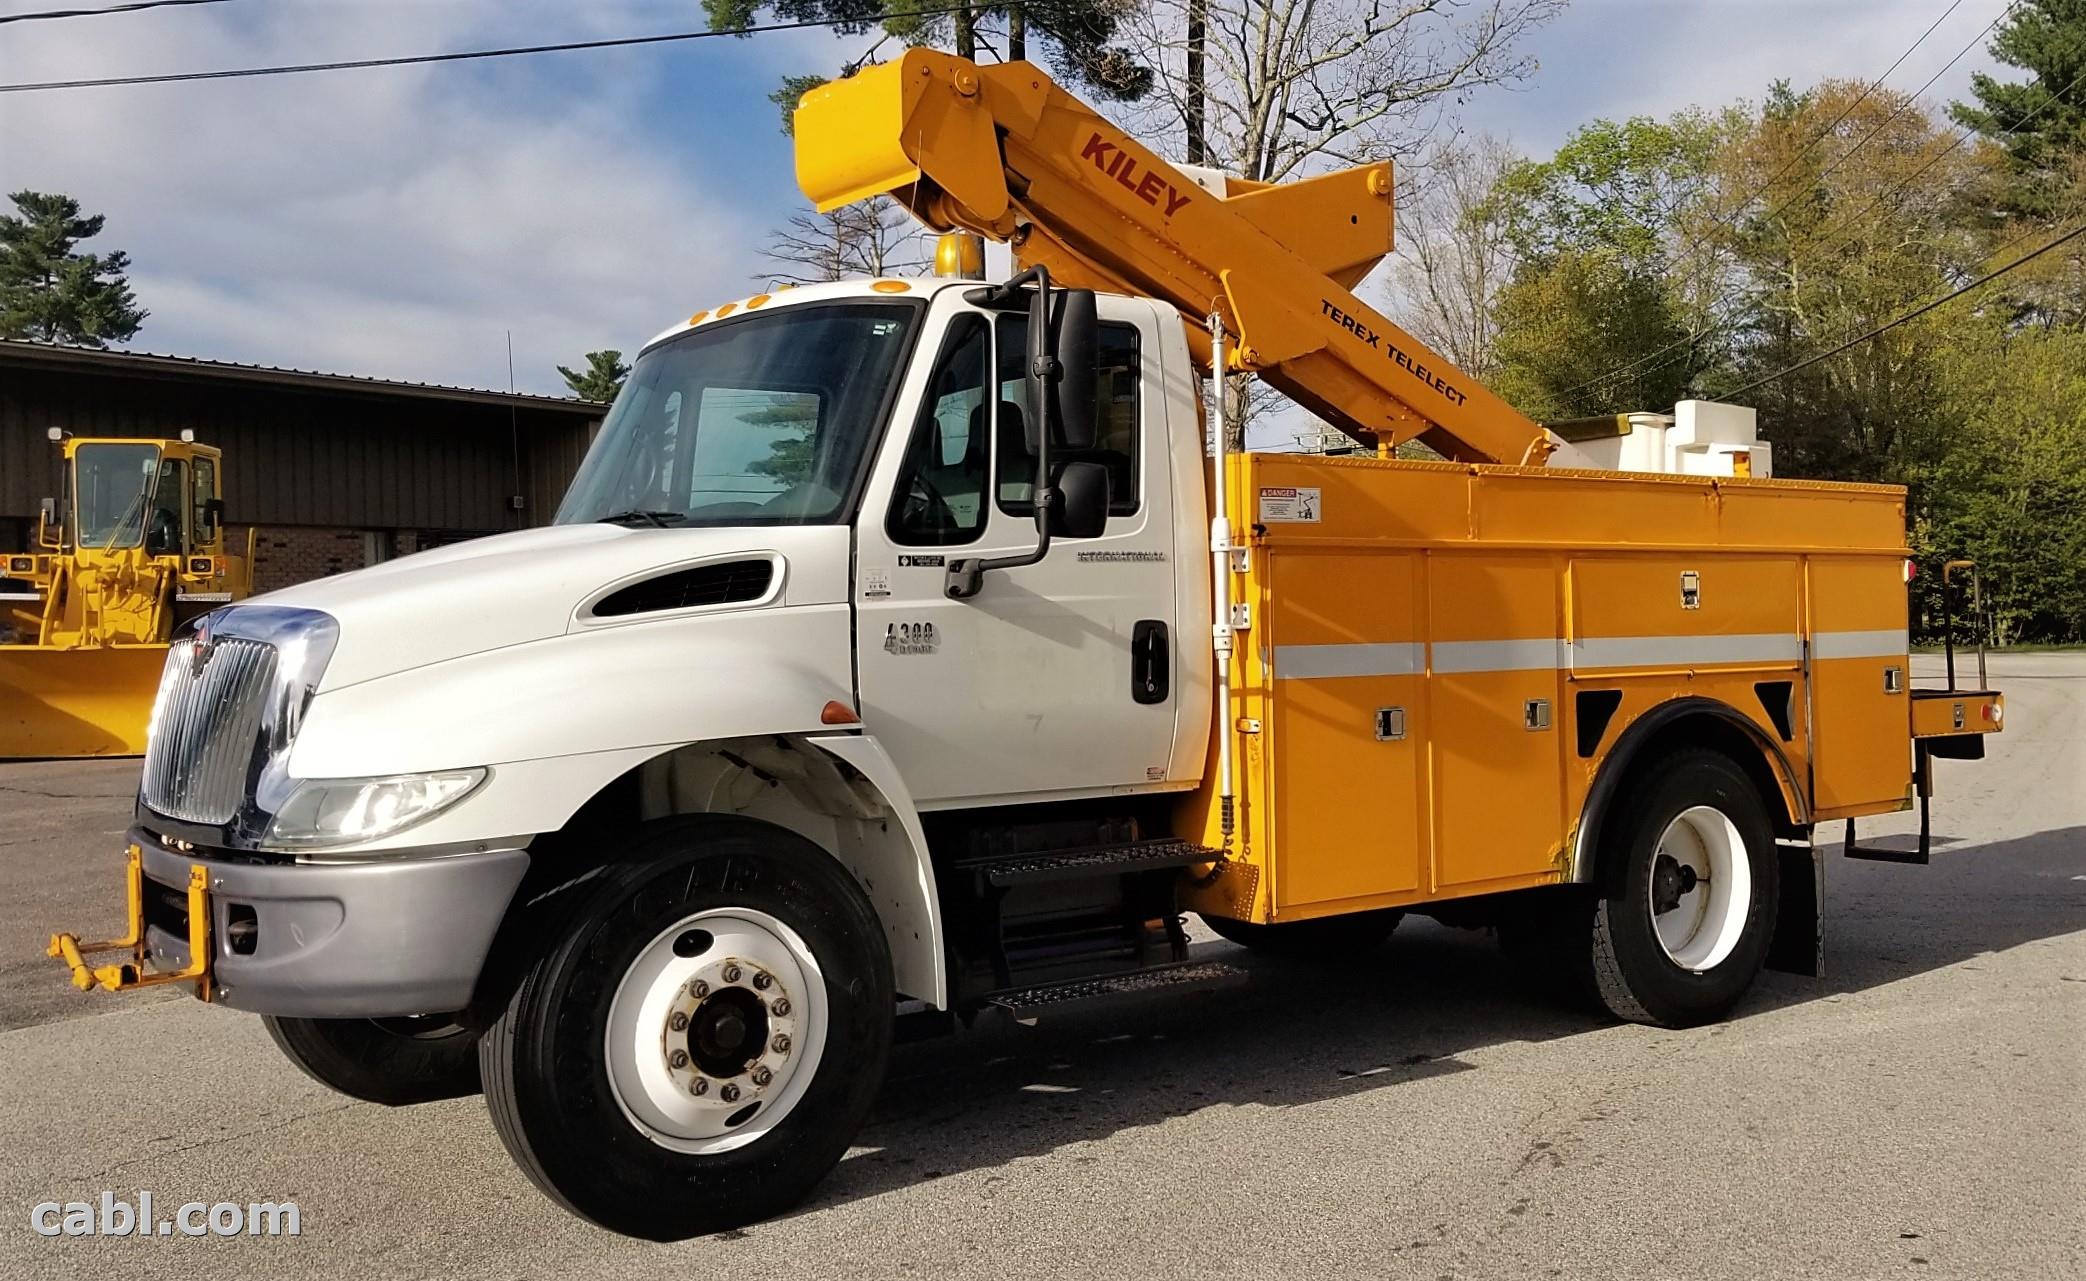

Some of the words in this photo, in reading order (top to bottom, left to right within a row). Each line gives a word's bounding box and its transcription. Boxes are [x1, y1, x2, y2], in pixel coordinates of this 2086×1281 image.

[1081, 132, 1192, 217] KILEY
[1321, 299, 1380, 348] TEREX
[1387, 343, 1468, 406] TELELECT
[1267, 489, 1295, 497] DANGER
[885, 622, 933, 650] 4300
